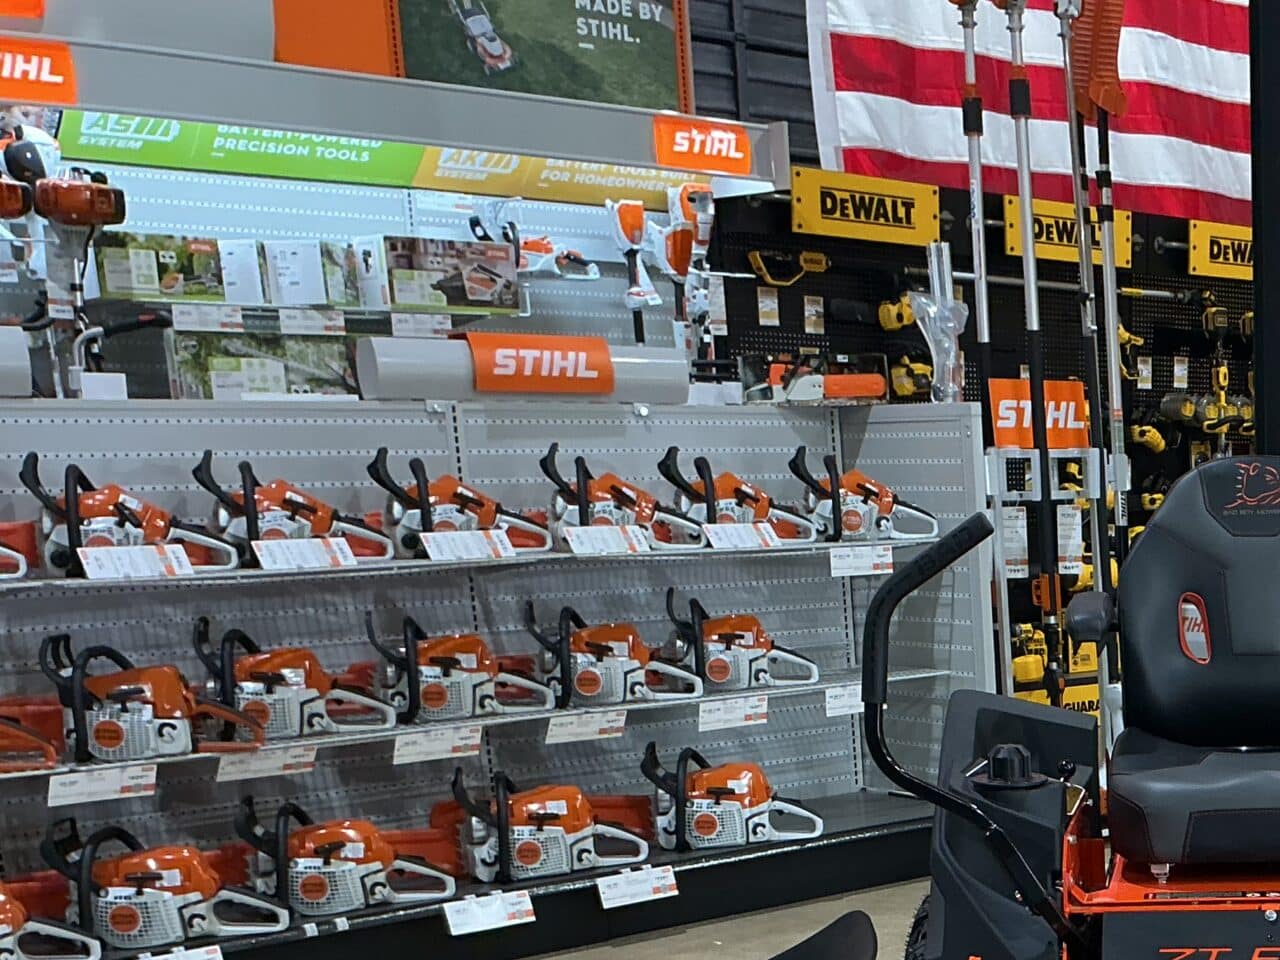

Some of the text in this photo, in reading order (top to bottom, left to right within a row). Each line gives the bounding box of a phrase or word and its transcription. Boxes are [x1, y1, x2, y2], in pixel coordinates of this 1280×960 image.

[575, 0, 663, 22] MADE BY
[576, 17, 641, 43] STIHL.
[0, 52, 64, 84] IHL
[78, 135, 144, 150] SYSTEM
[213, 137, 370, 162] PRECISION TOOLS
[540, 170, 570, 182] FOR
[820, 190, 915, 225] DEWALT
[1034, 216, 1102, 250] DEWL
[1209, 236, 1252, 263] DEWA
[493, 348, 599, 379] STIHL
[997, 399, 1085, 429] STHL
